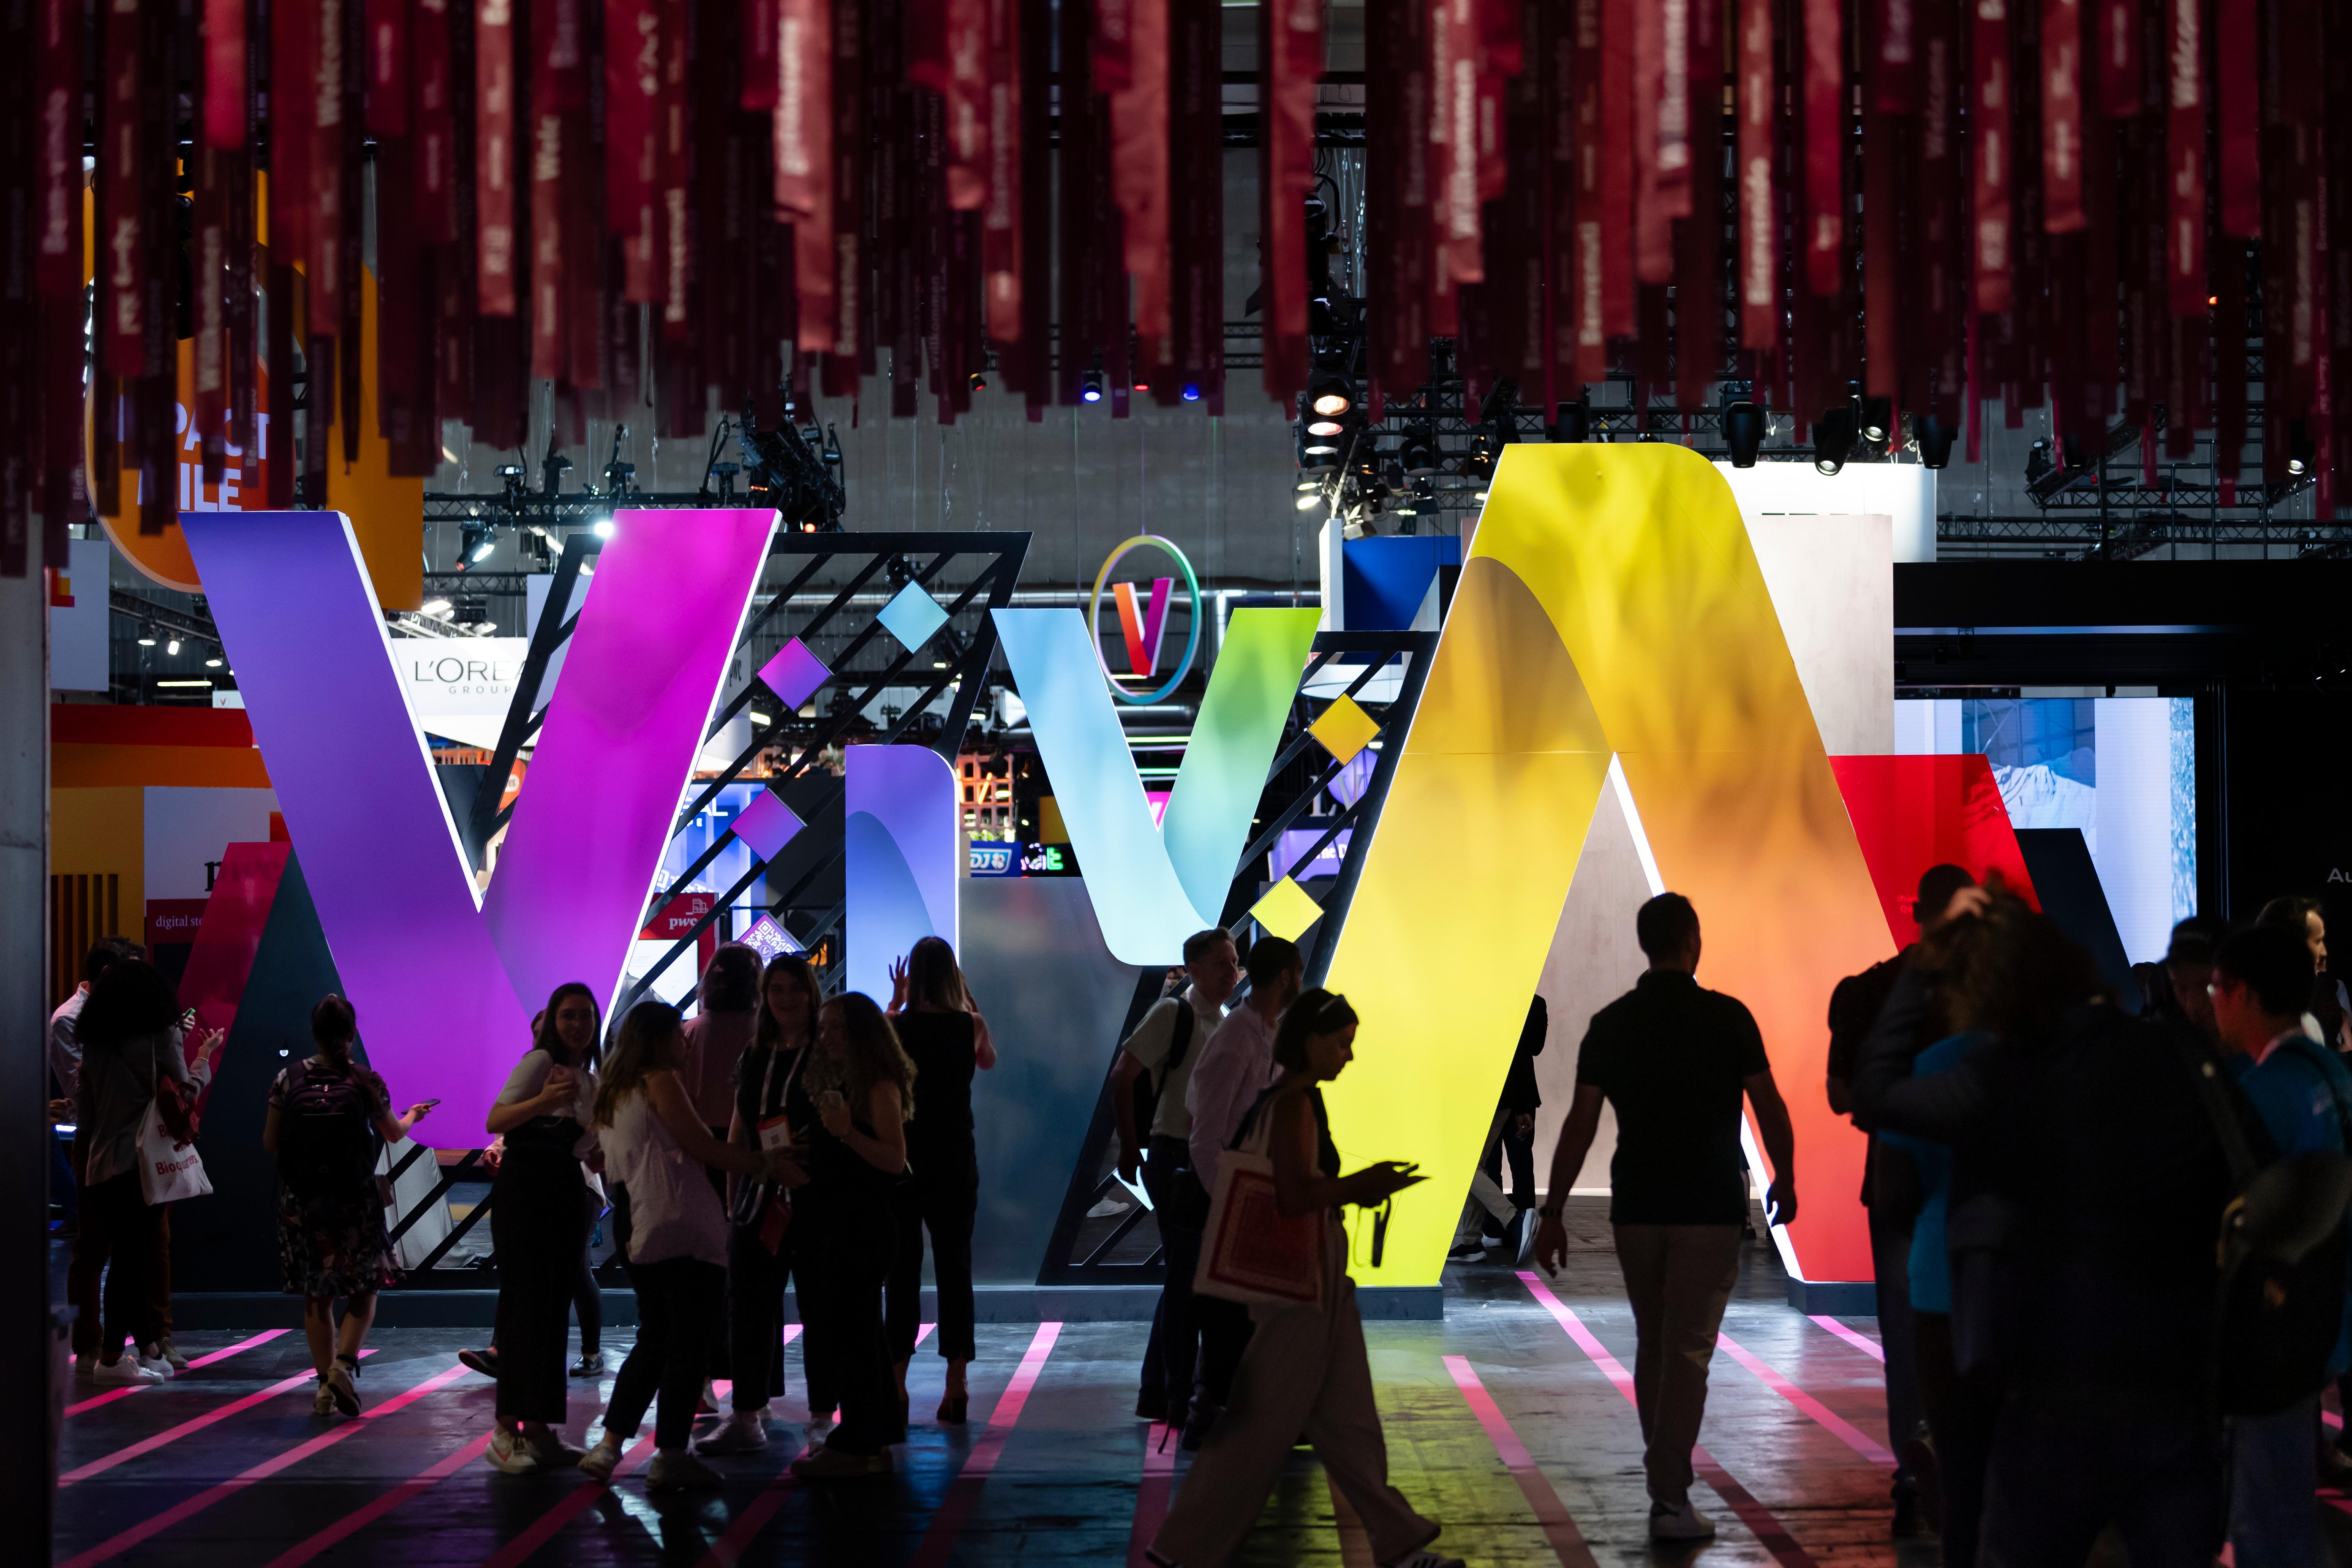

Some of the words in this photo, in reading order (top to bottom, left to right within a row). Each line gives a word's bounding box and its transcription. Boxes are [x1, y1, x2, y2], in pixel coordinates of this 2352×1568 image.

[138, 463, 242, 511] ILE
[156, 915, 188, 930] digital
[669, 917, 698, 930] pwc
